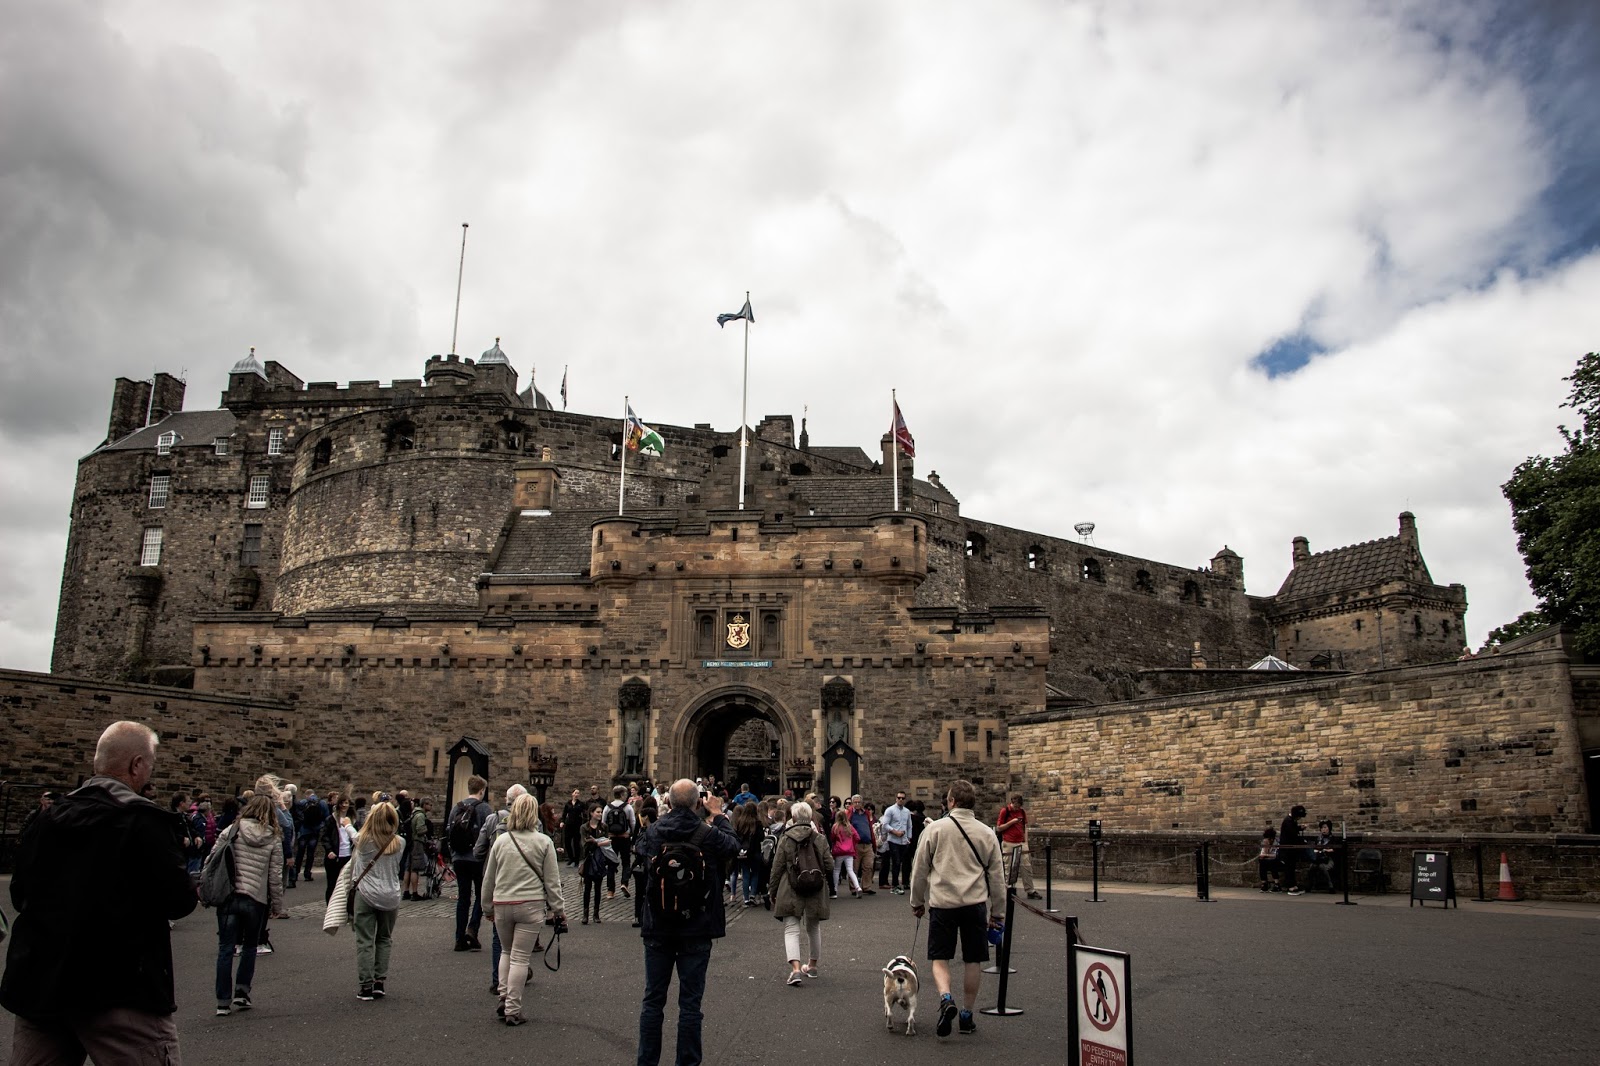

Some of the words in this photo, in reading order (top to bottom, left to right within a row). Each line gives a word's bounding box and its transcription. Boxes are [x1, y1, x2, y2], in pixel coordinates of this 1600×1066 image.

[1082, 1043, 1091, 1052] NO
[1091, 1046, 1125, 1062] PEDESTRIAN
[1091, 1055, 1108, 1066] ENTRY
